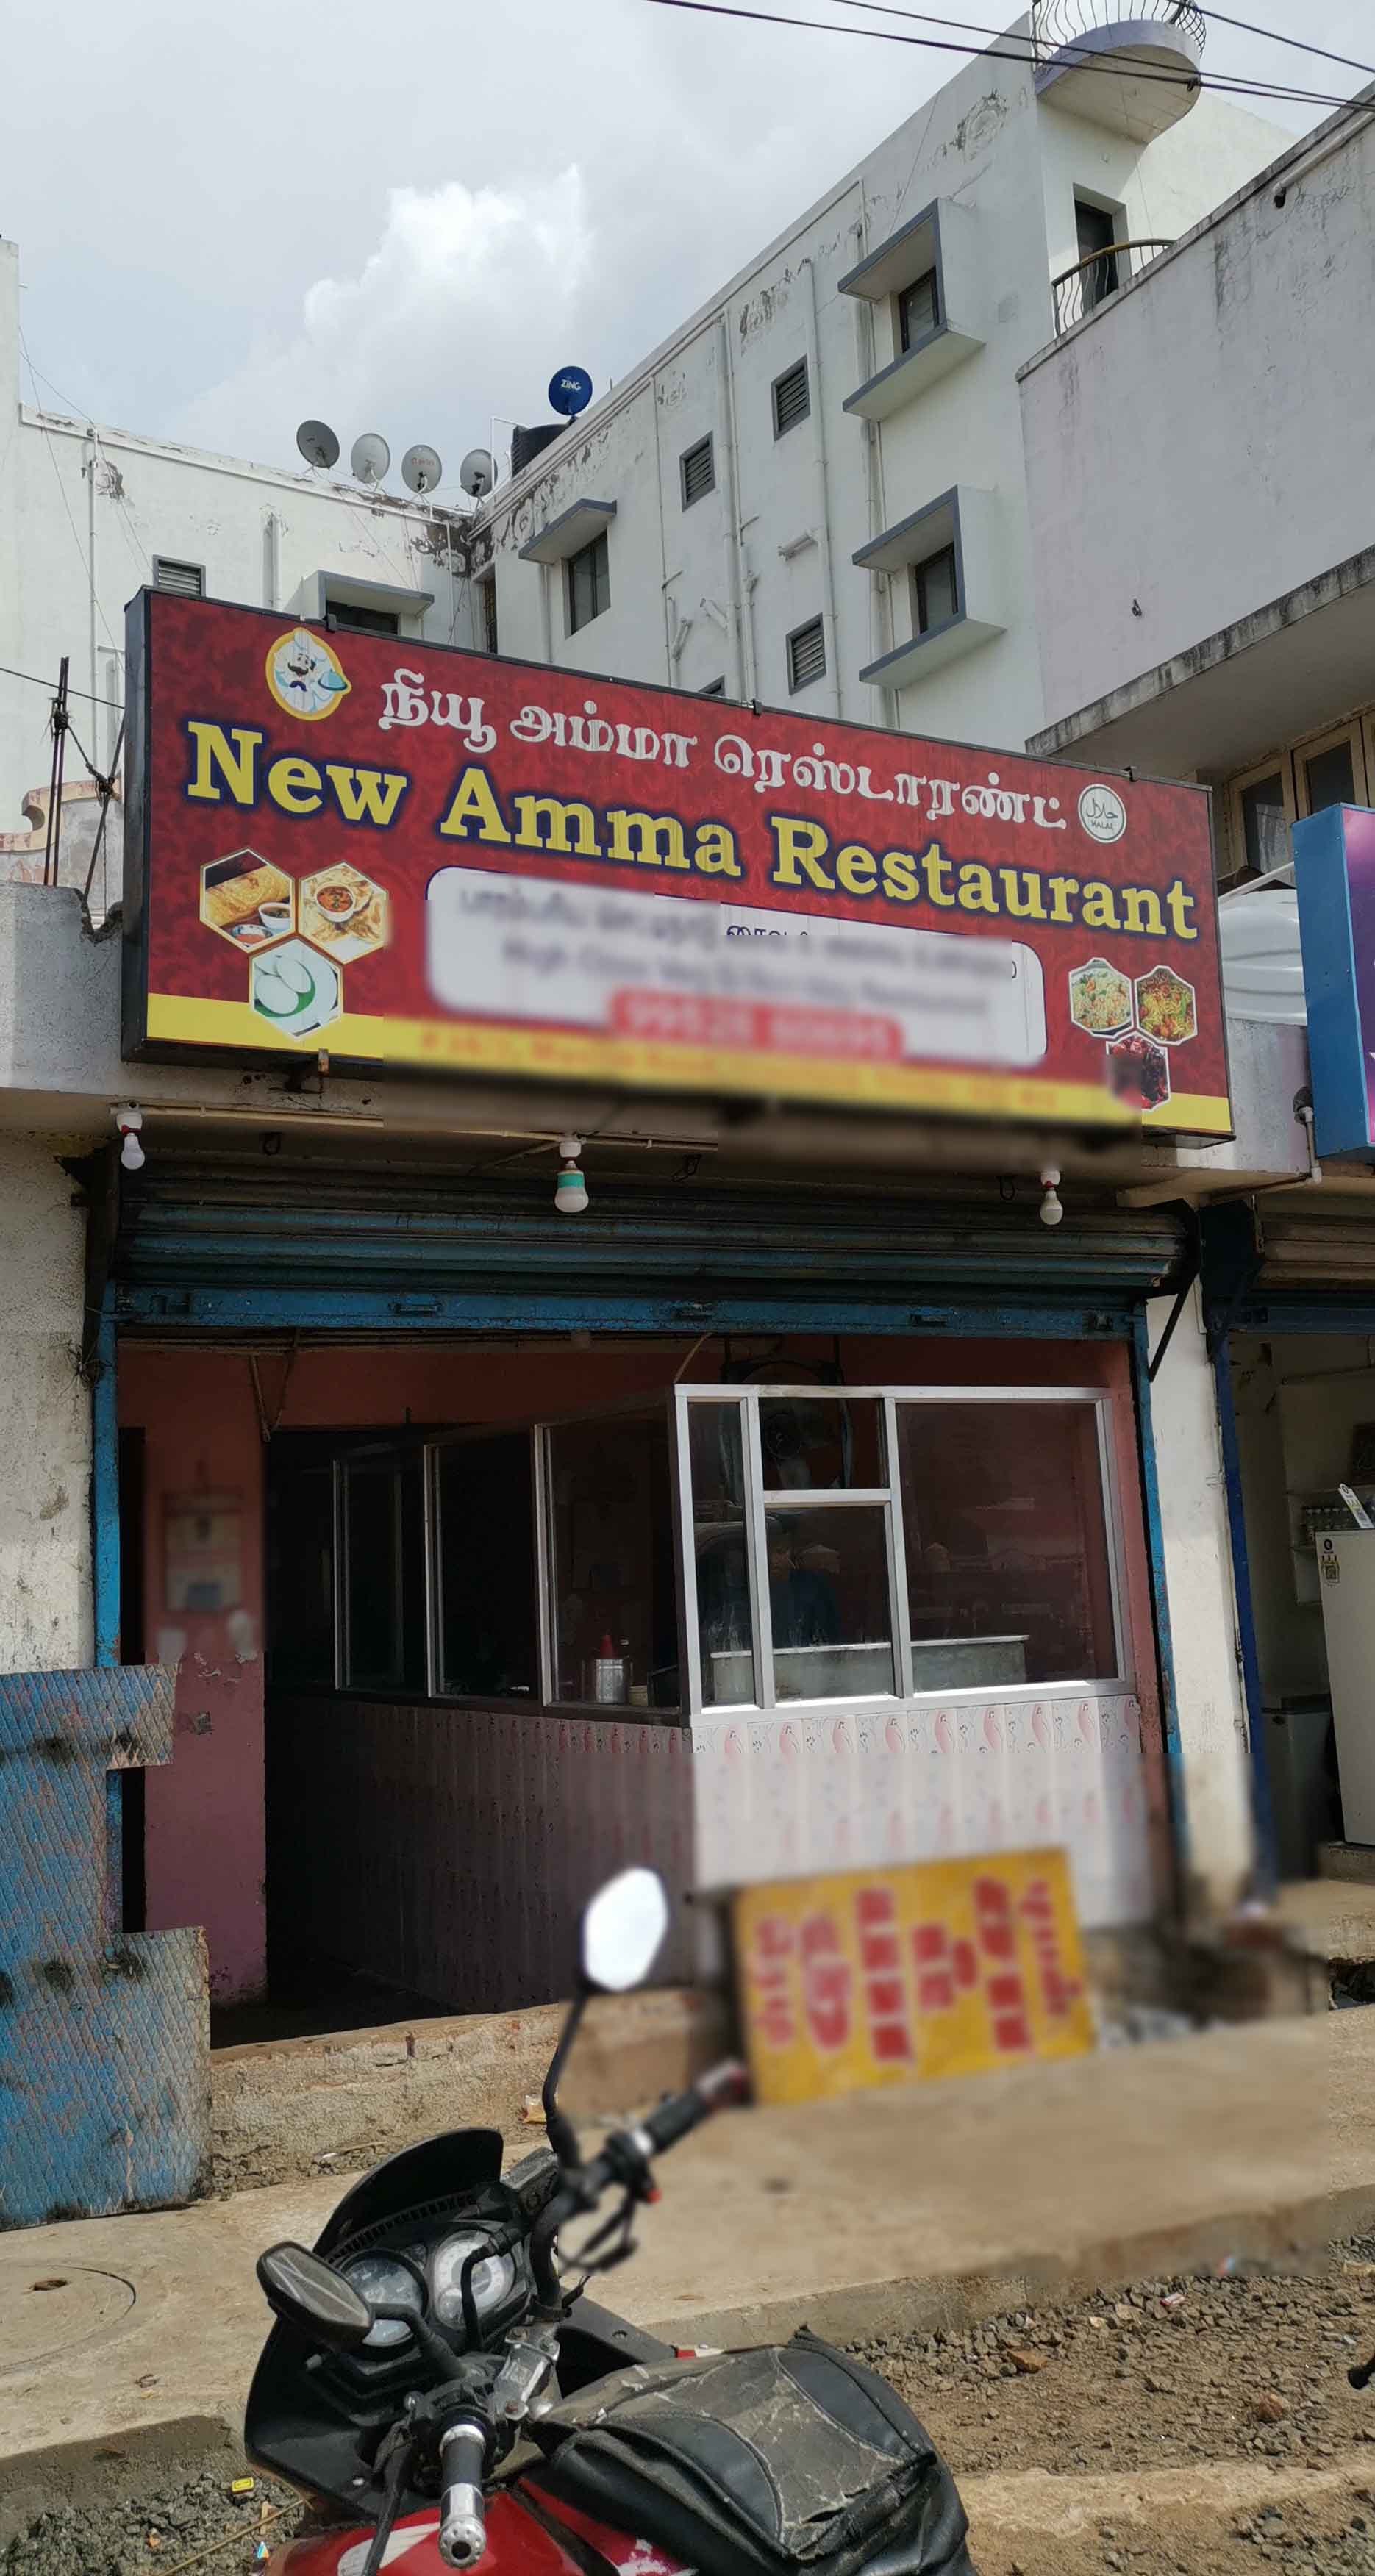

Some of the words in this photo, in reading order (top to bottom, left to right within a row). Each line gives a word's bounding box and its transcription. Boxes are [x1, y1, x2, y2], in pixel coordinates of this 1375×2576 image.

[560, 379, 582, 390] ZING
[379, 668, 497, 753] நியூ
[510, 701, 698, 768] அம்மா
[714, 734, 1067, 829] ரெஸ்டாரண்ட்
[188, 720, 407, 825] New
[440, 768, 740, 876] Amma
[772, 816, 1198, 939] Restaurant
